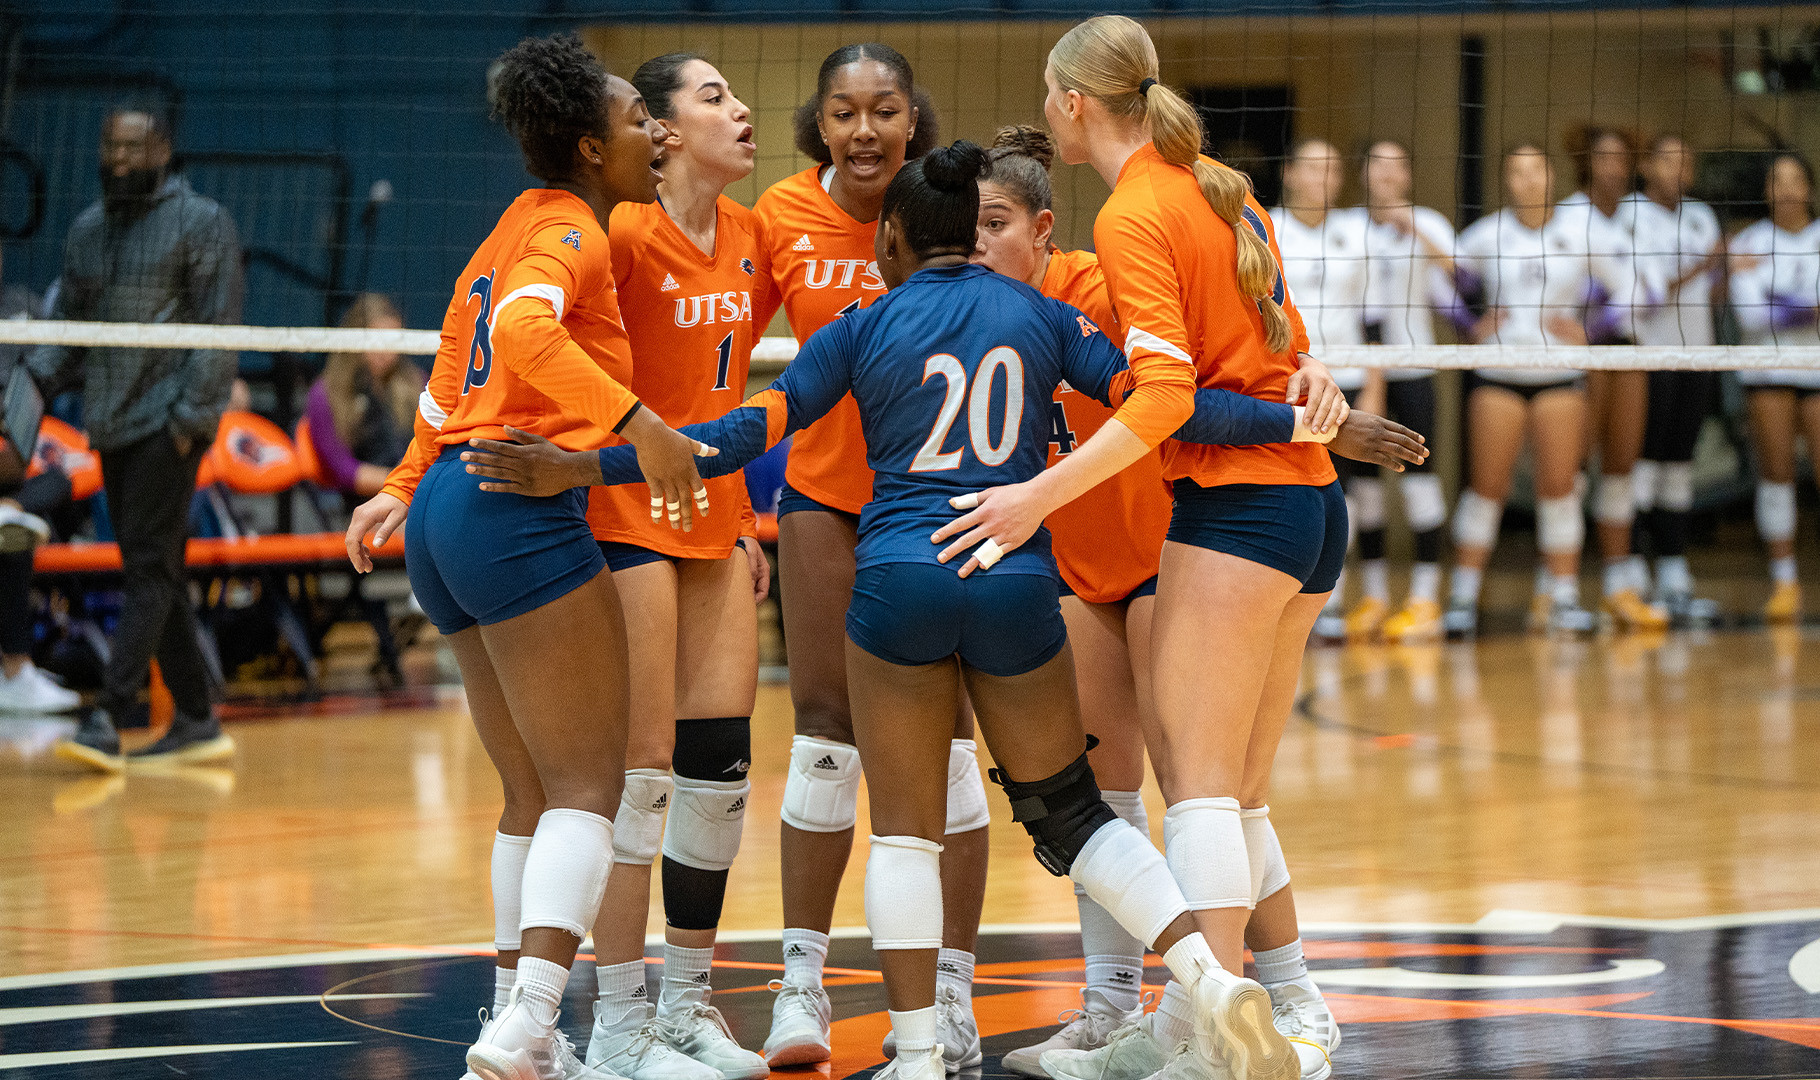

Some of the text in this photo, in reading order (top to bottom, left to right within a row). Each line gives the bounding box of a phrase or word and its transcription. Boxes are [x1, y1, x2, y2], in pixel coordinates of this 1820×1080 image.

[803, 259, 888, 290] UTS
[674, 291, 753, 328] UTSA
[711, 330, 734, 391] 1
[908, 345, 1025, 473] 20
